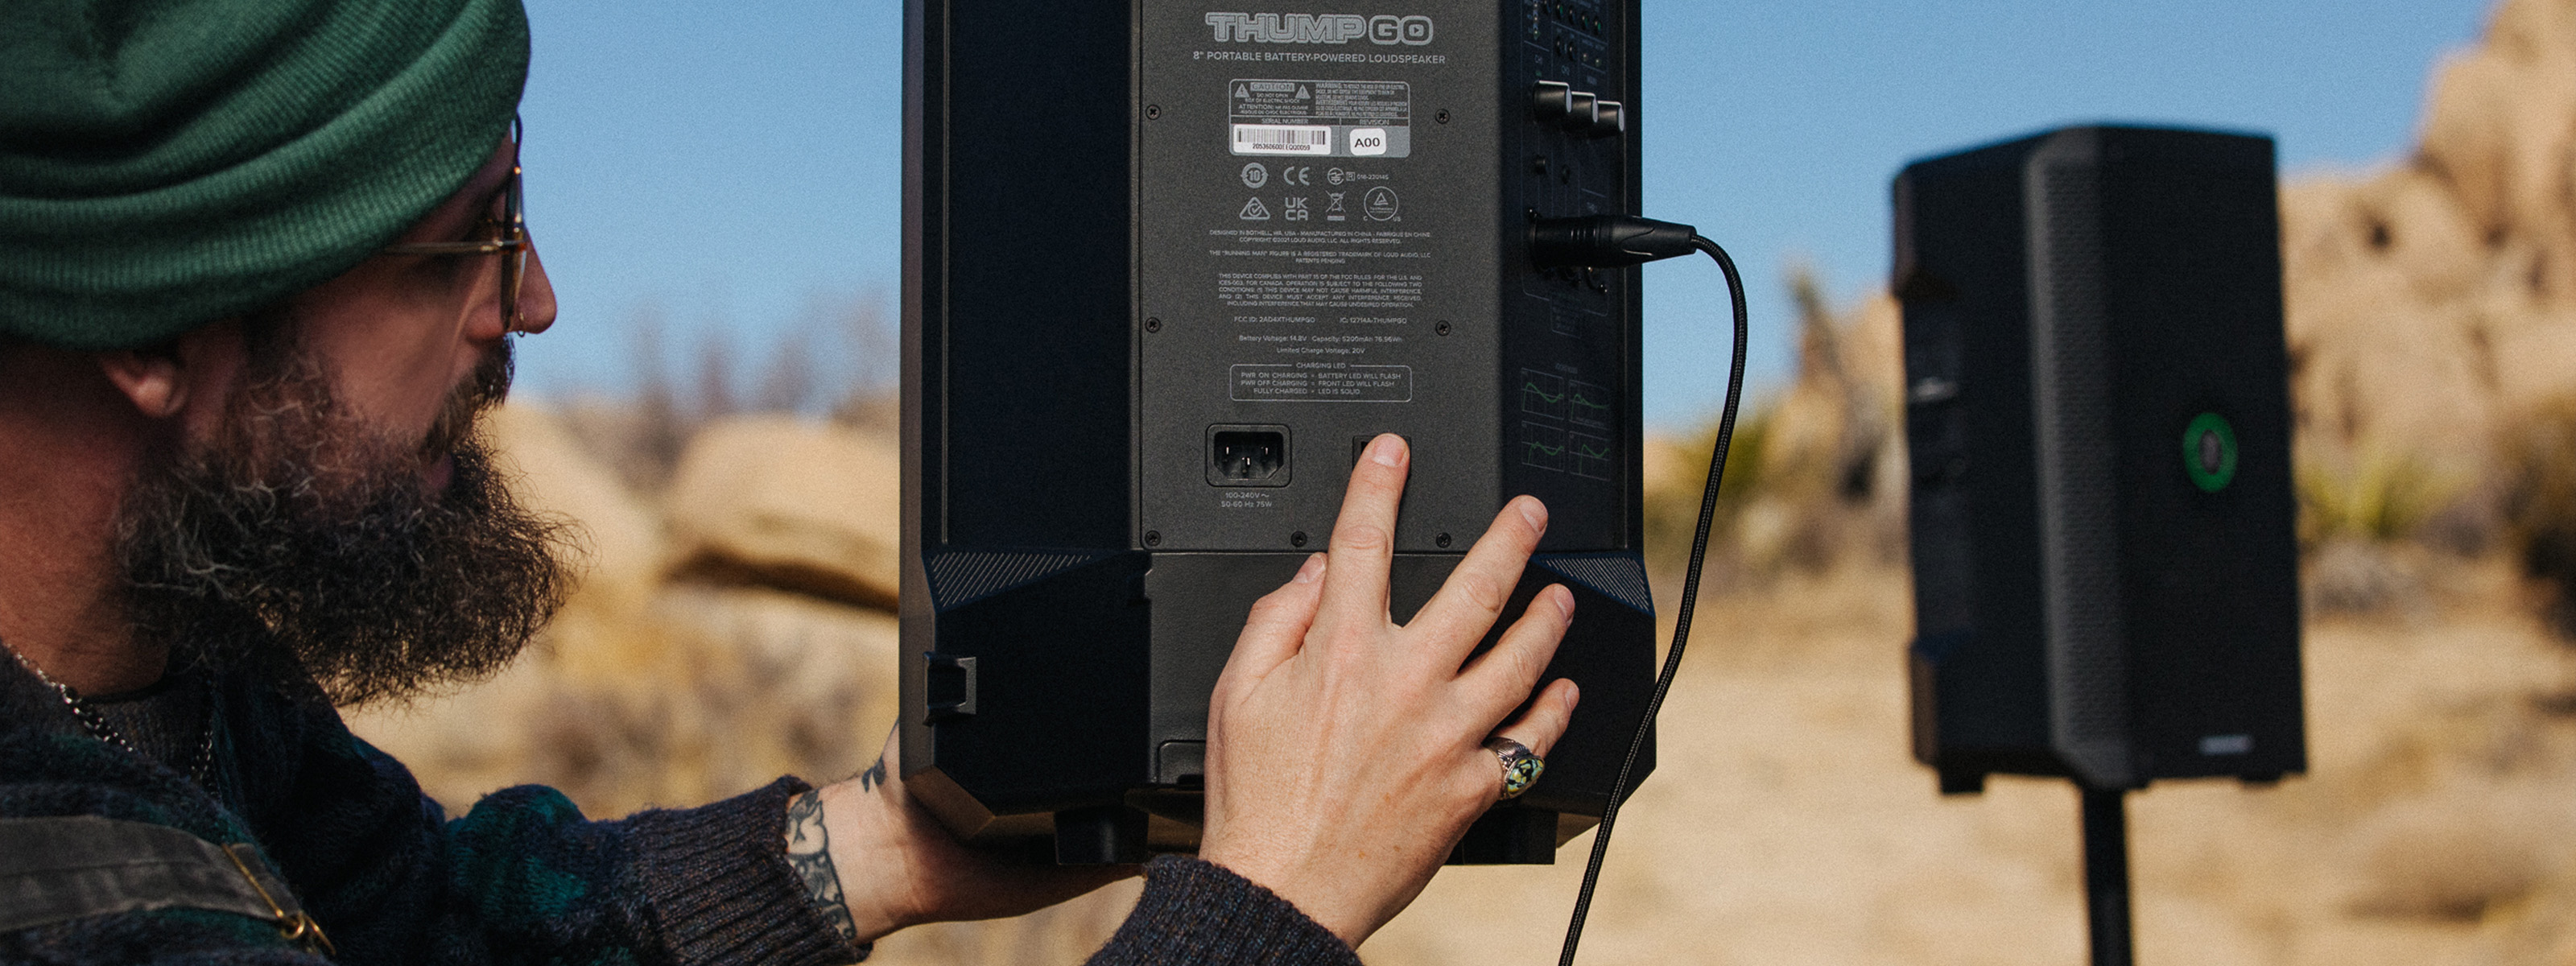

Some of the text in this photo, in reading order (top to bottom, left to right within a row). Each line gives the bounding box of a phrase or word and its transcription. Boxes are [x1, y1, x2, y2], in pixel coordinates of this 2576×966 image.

[1205, 12, 1434, 45] THUMP GO
[1207, 52, 1261, 61] PORTABLE
[1265, 52, 1365, 63] BATTERY-POWERED
[1368, 54, 1445, 64] LOUDSPEAKER
[1251, 83, 1294, 91] CAUTION
[1355, 138, 1381, 147] A00
[1249, 170, 1261, 181] 10
[1283, 166, 1310, 186] CE
[1285, 197, 1307, 208] UK
[1285, 209, 1308, 221] CA
